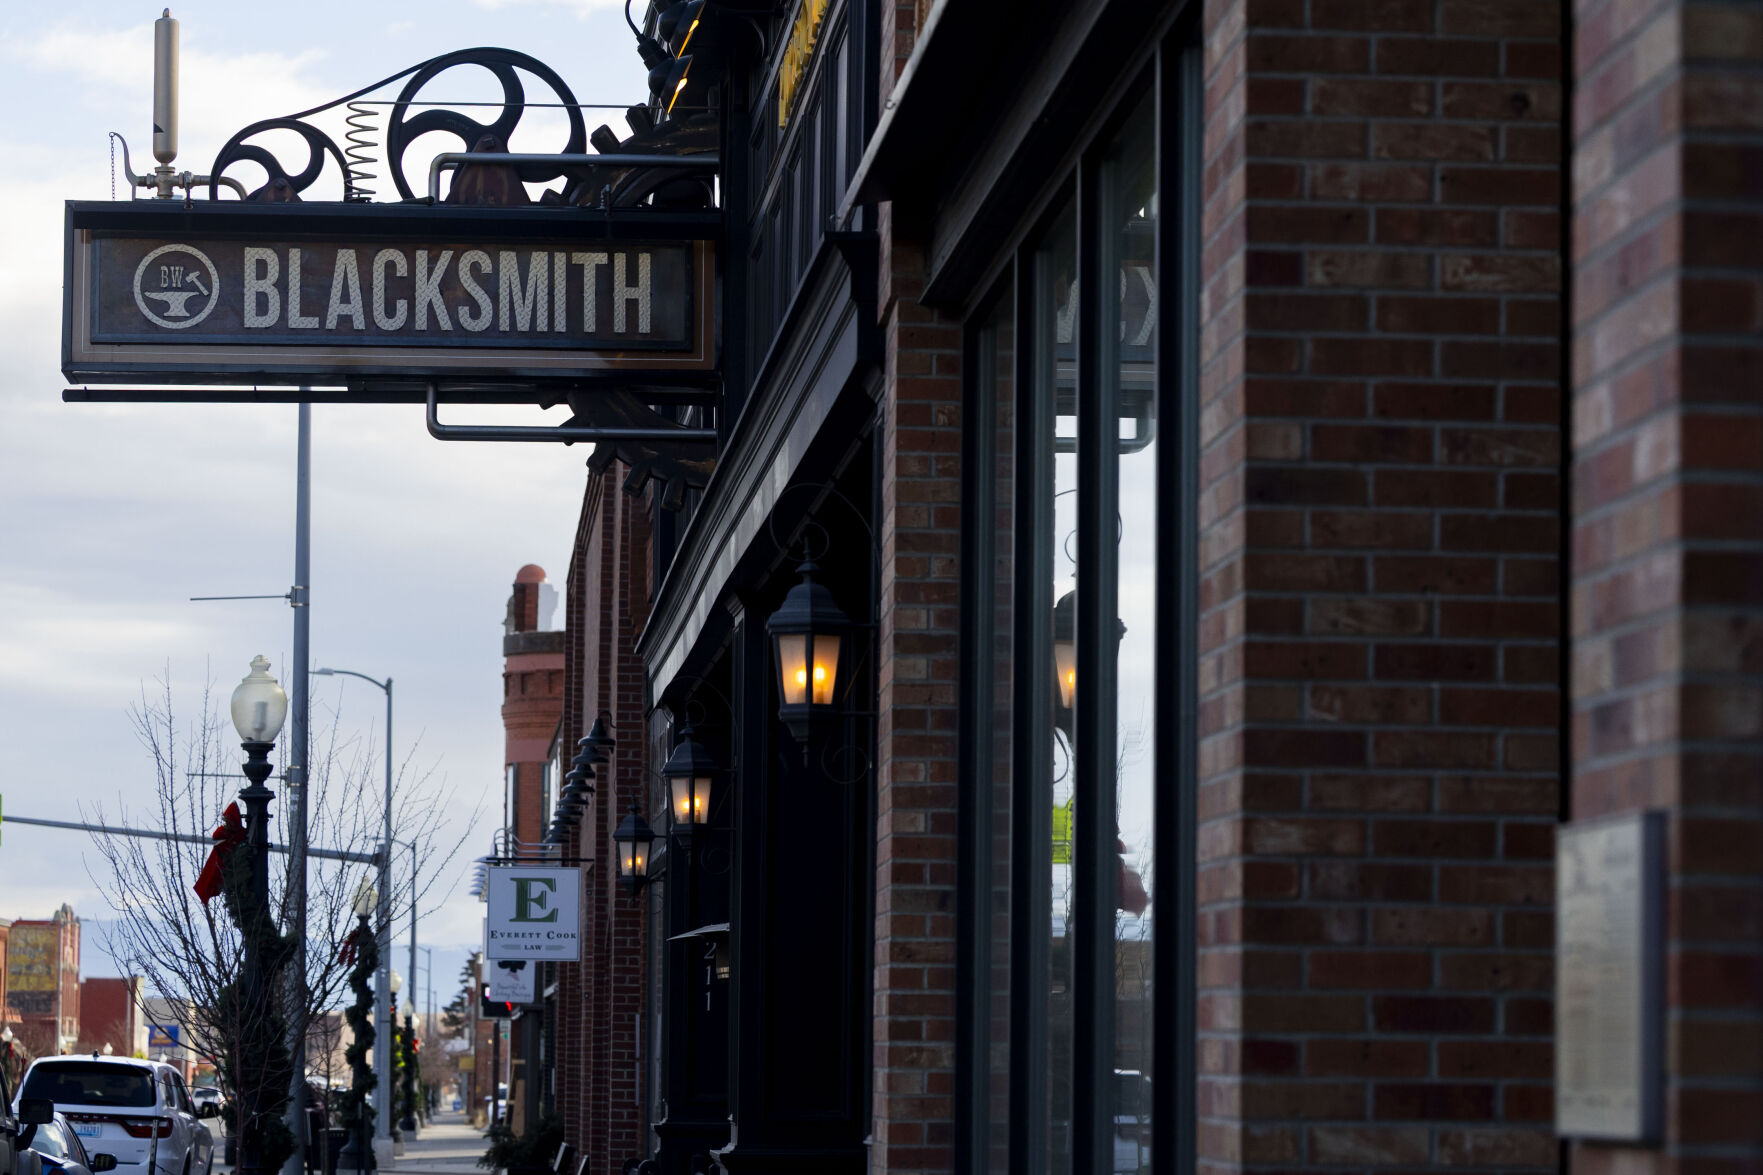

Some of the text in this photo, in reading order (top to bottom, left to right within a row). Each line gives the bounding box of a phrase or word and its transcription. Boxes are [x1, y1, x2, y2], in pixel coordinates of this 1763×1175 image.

[160, 265, 184, 288] BW
[243, 246, 652, 334] BLACKSMITH
[508, 877, 559, 923] E
[490, 930, 577, 940] EVERETT COOK
